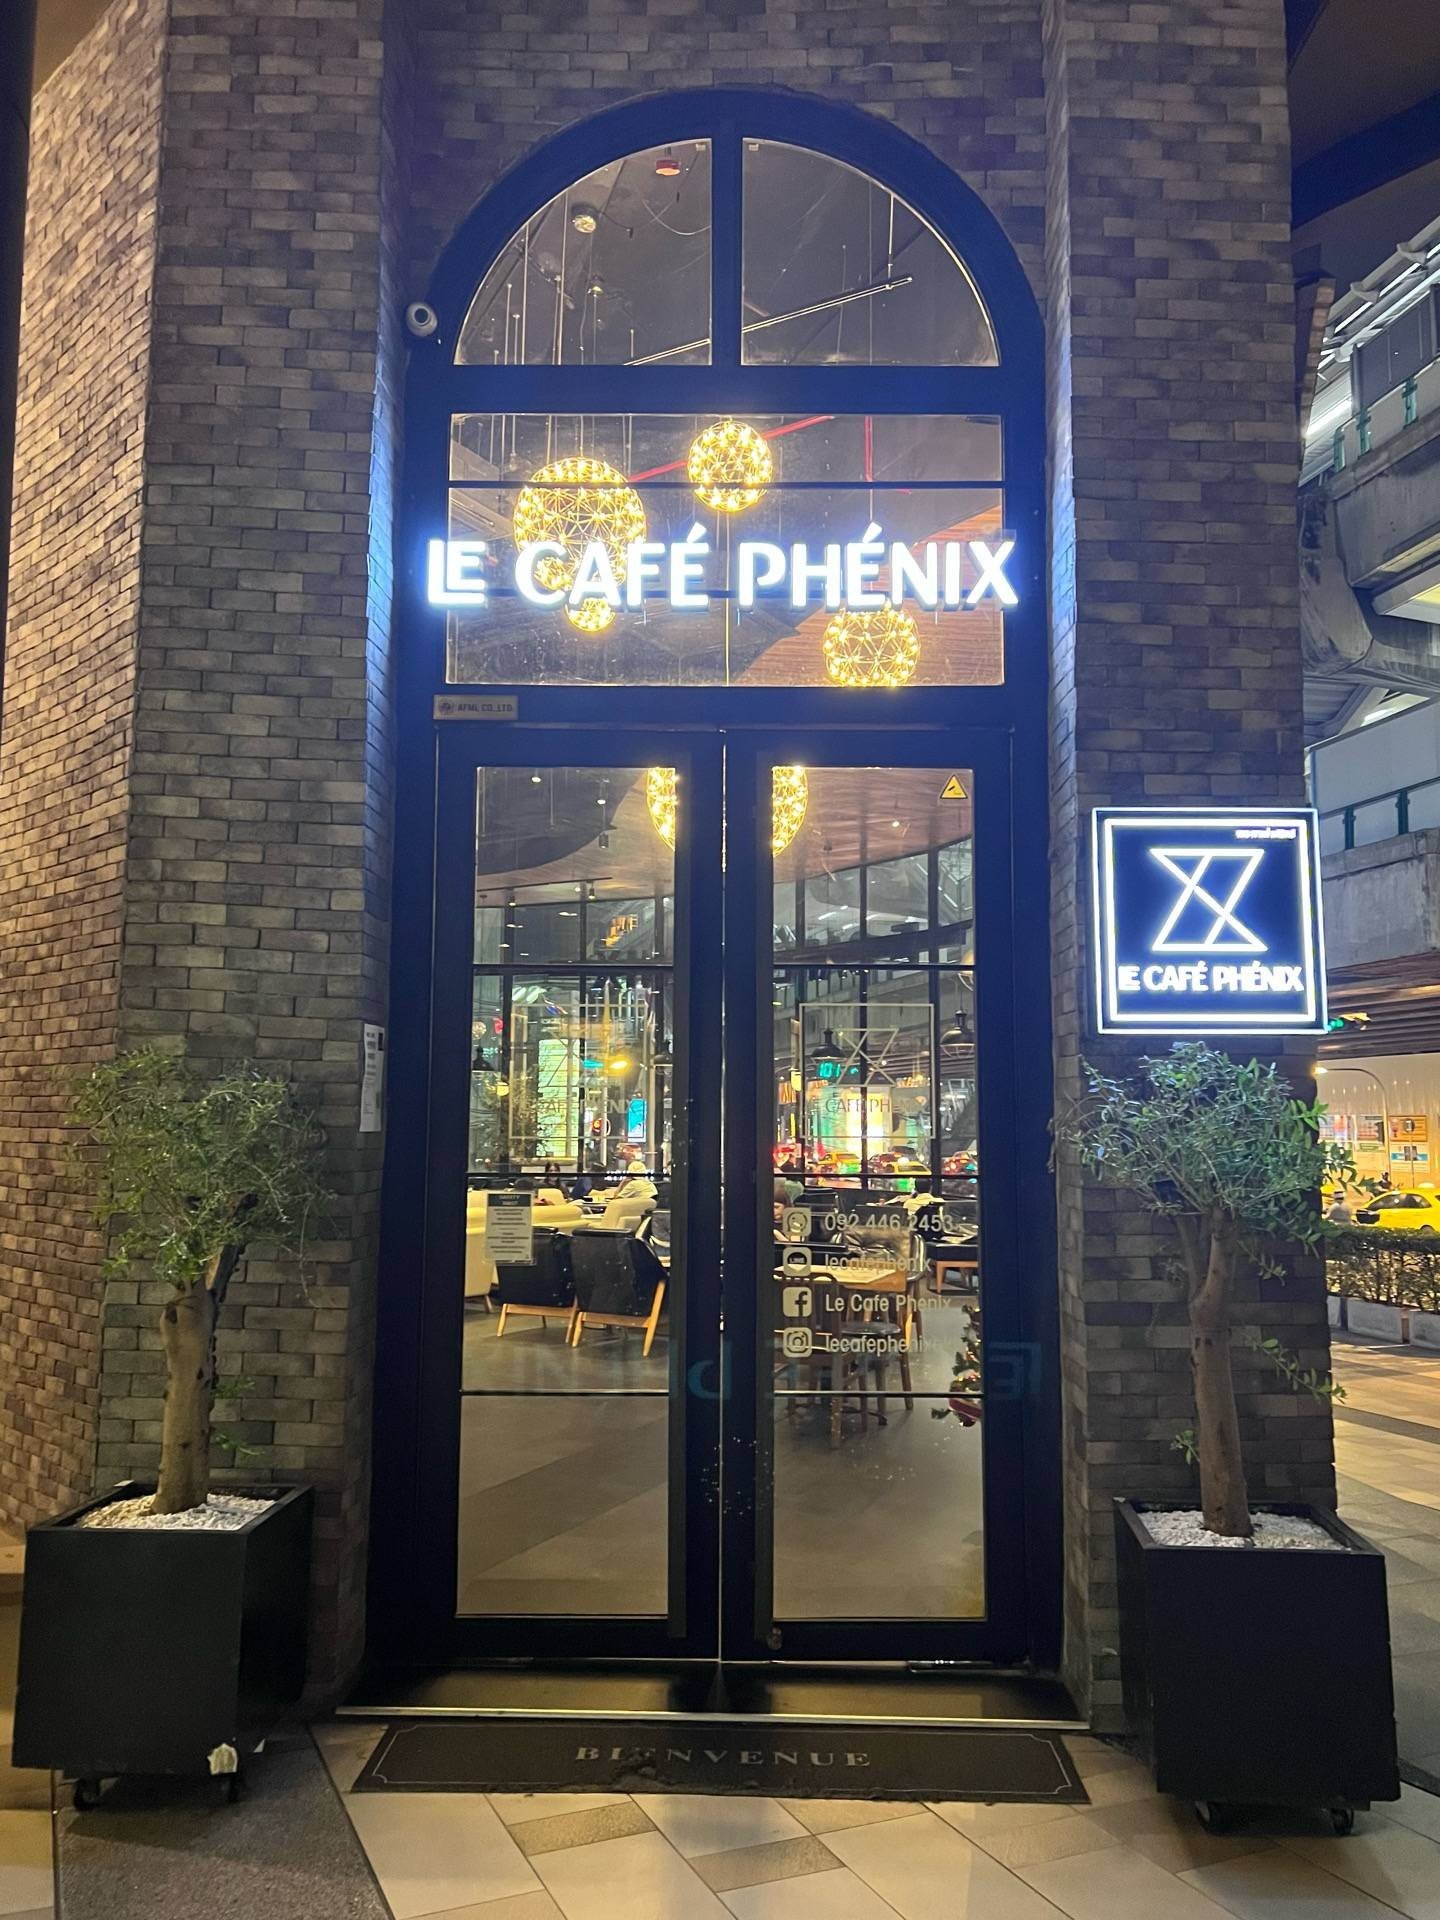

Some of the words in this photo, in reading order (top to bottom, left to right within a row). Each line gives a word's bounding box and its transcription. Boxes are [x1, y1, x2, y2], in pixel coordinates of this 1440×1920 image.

[426, 539, 486, 607] LE
[515, 522, 710, 608] CAFÉ
[737, 522, 1019, 610] PHÉNIX
[1143, 961, 1209, 992] CAFÉ
[1213, 961, 1305, 993] PHÉNIX
[824, 1213, 861, 1232] 092
[865, 1213, 901, 1232] 446
[907, 1213, 954, 1233] 2453
[824, 1253, 932, 1276] lecafephenx
[824, 1294, 845, 1312] Le
[850, 1294, 890, 1312] Cafe
[895, 1294, 952, 1312] Phenix
